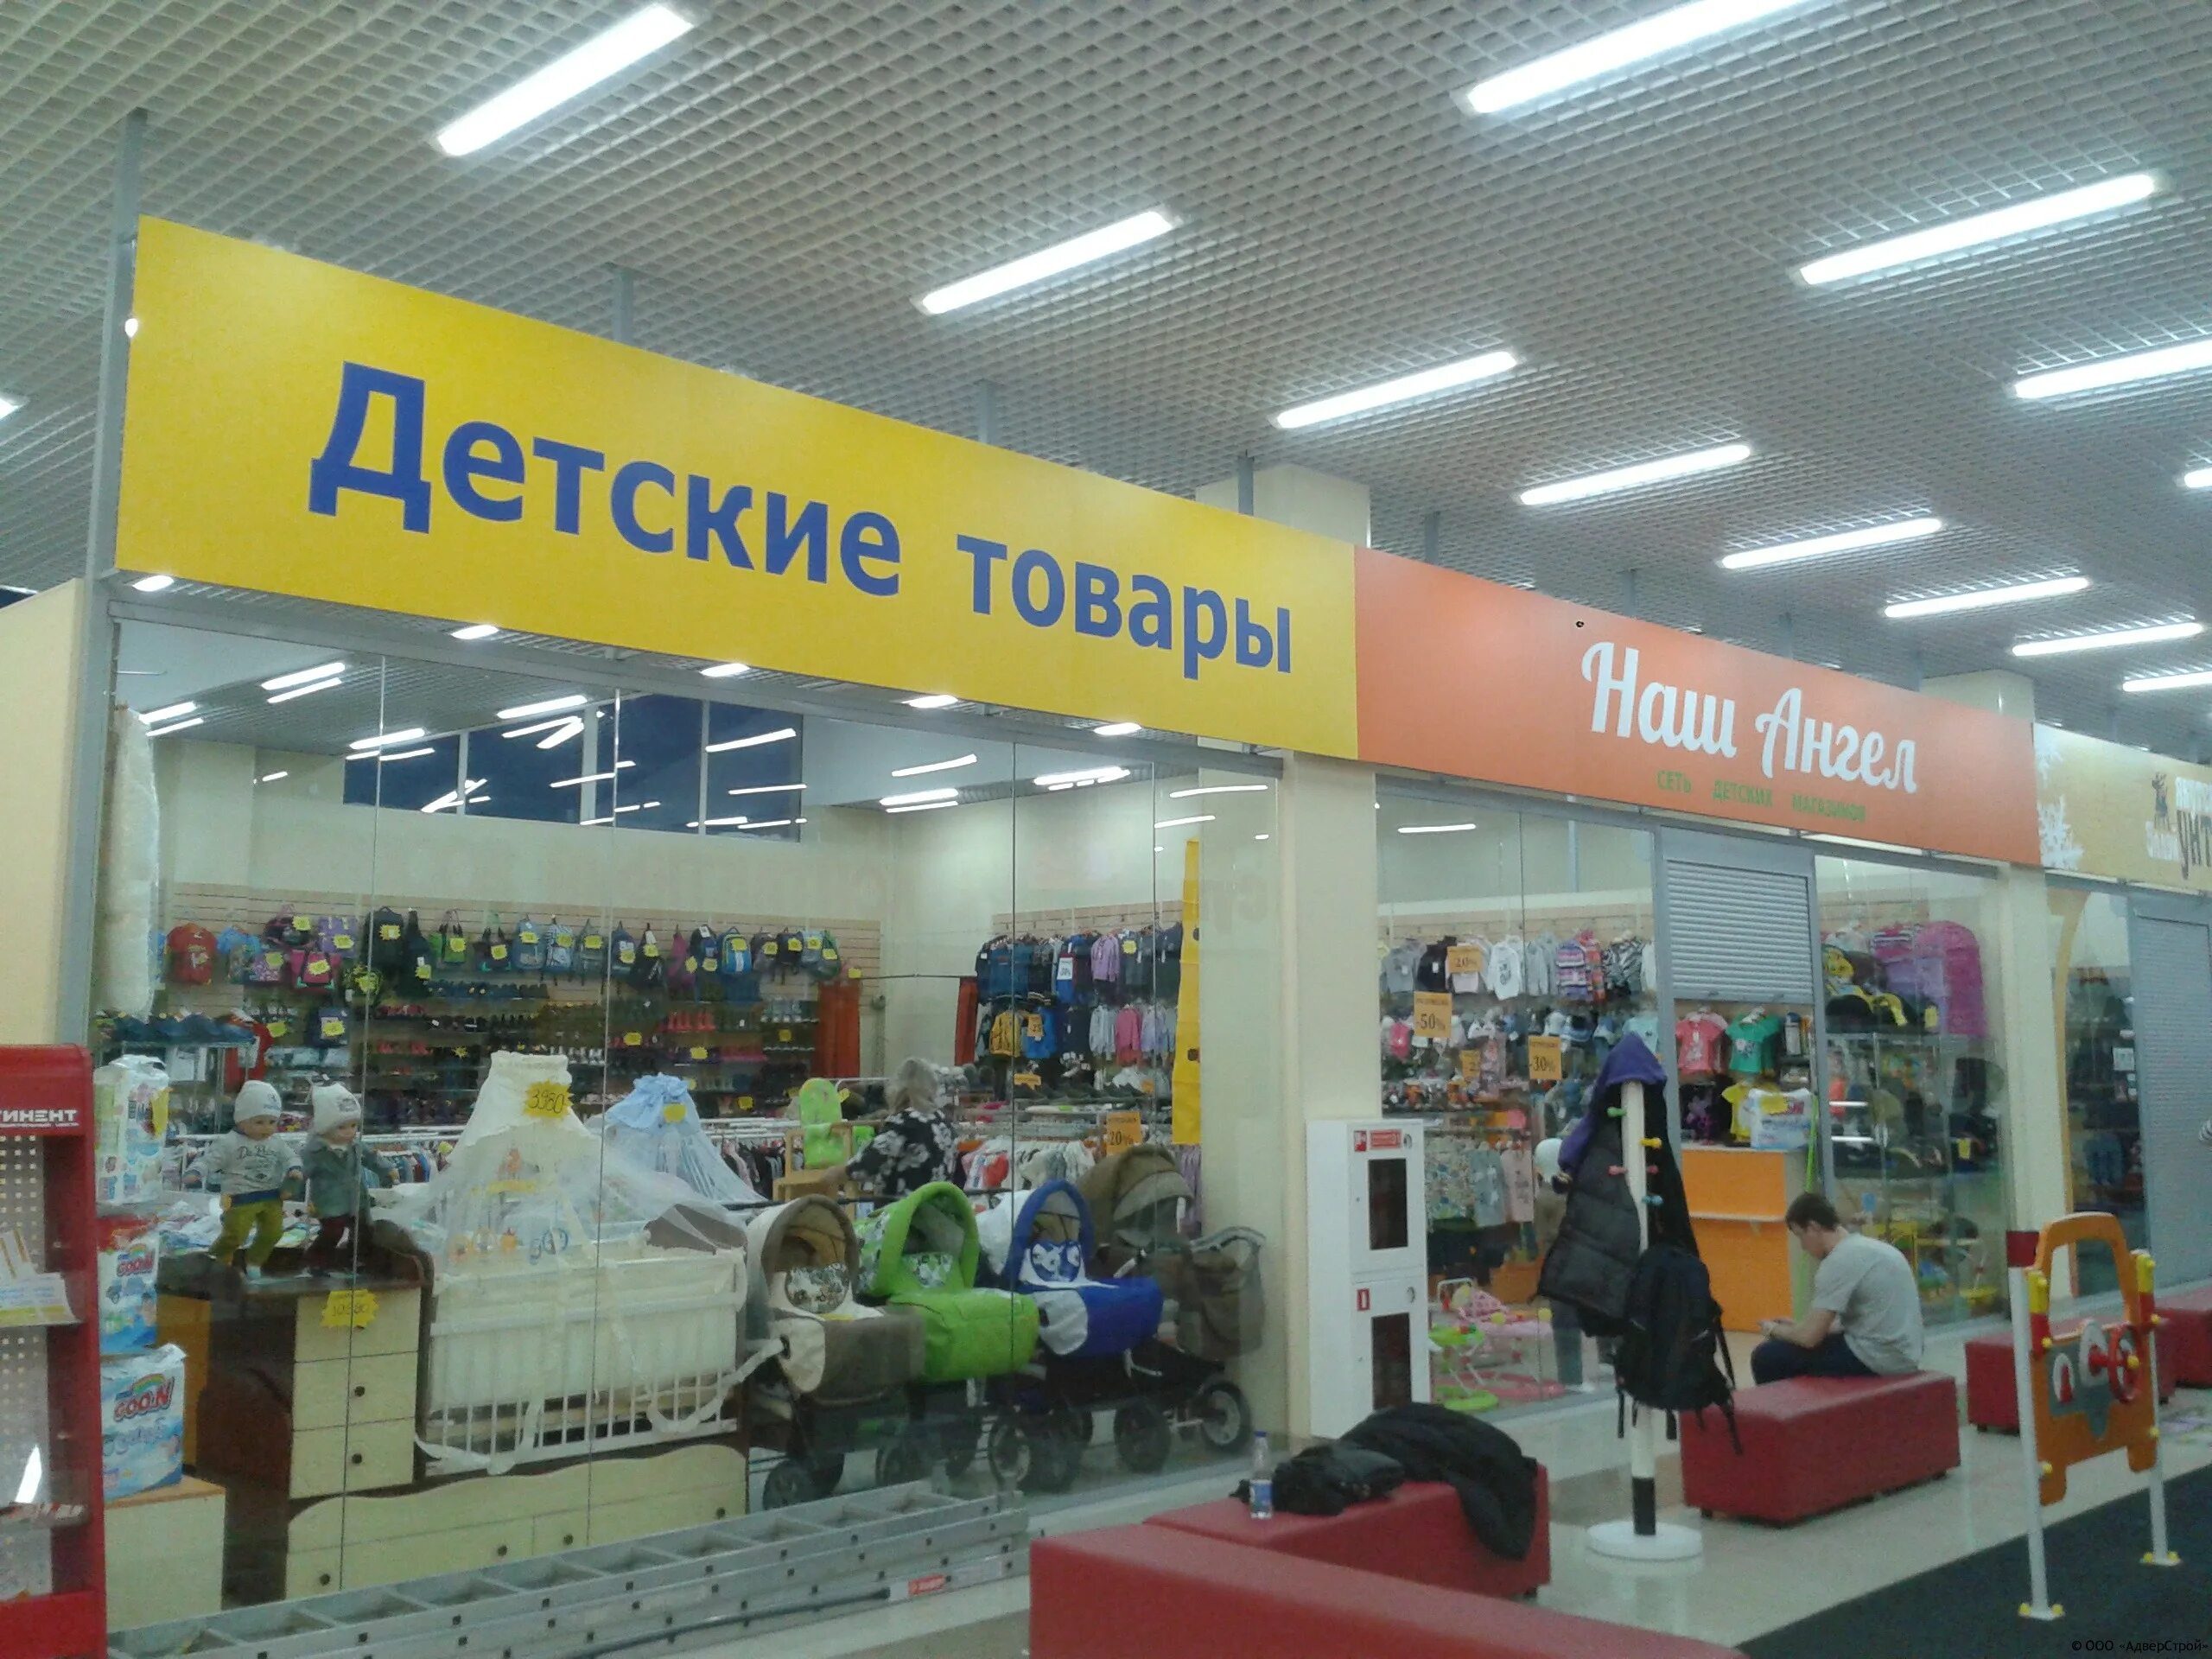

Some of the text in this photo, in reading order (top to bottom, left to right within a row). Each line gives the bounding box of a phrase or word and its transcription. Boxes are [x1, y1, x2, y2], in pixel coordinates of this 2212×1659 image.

[308, 360, 1291, 681] Детские товары
[1581, 641, 1917, 794] Наш Ангел
[1657, 770, 1692, 794] СЕТЬ
